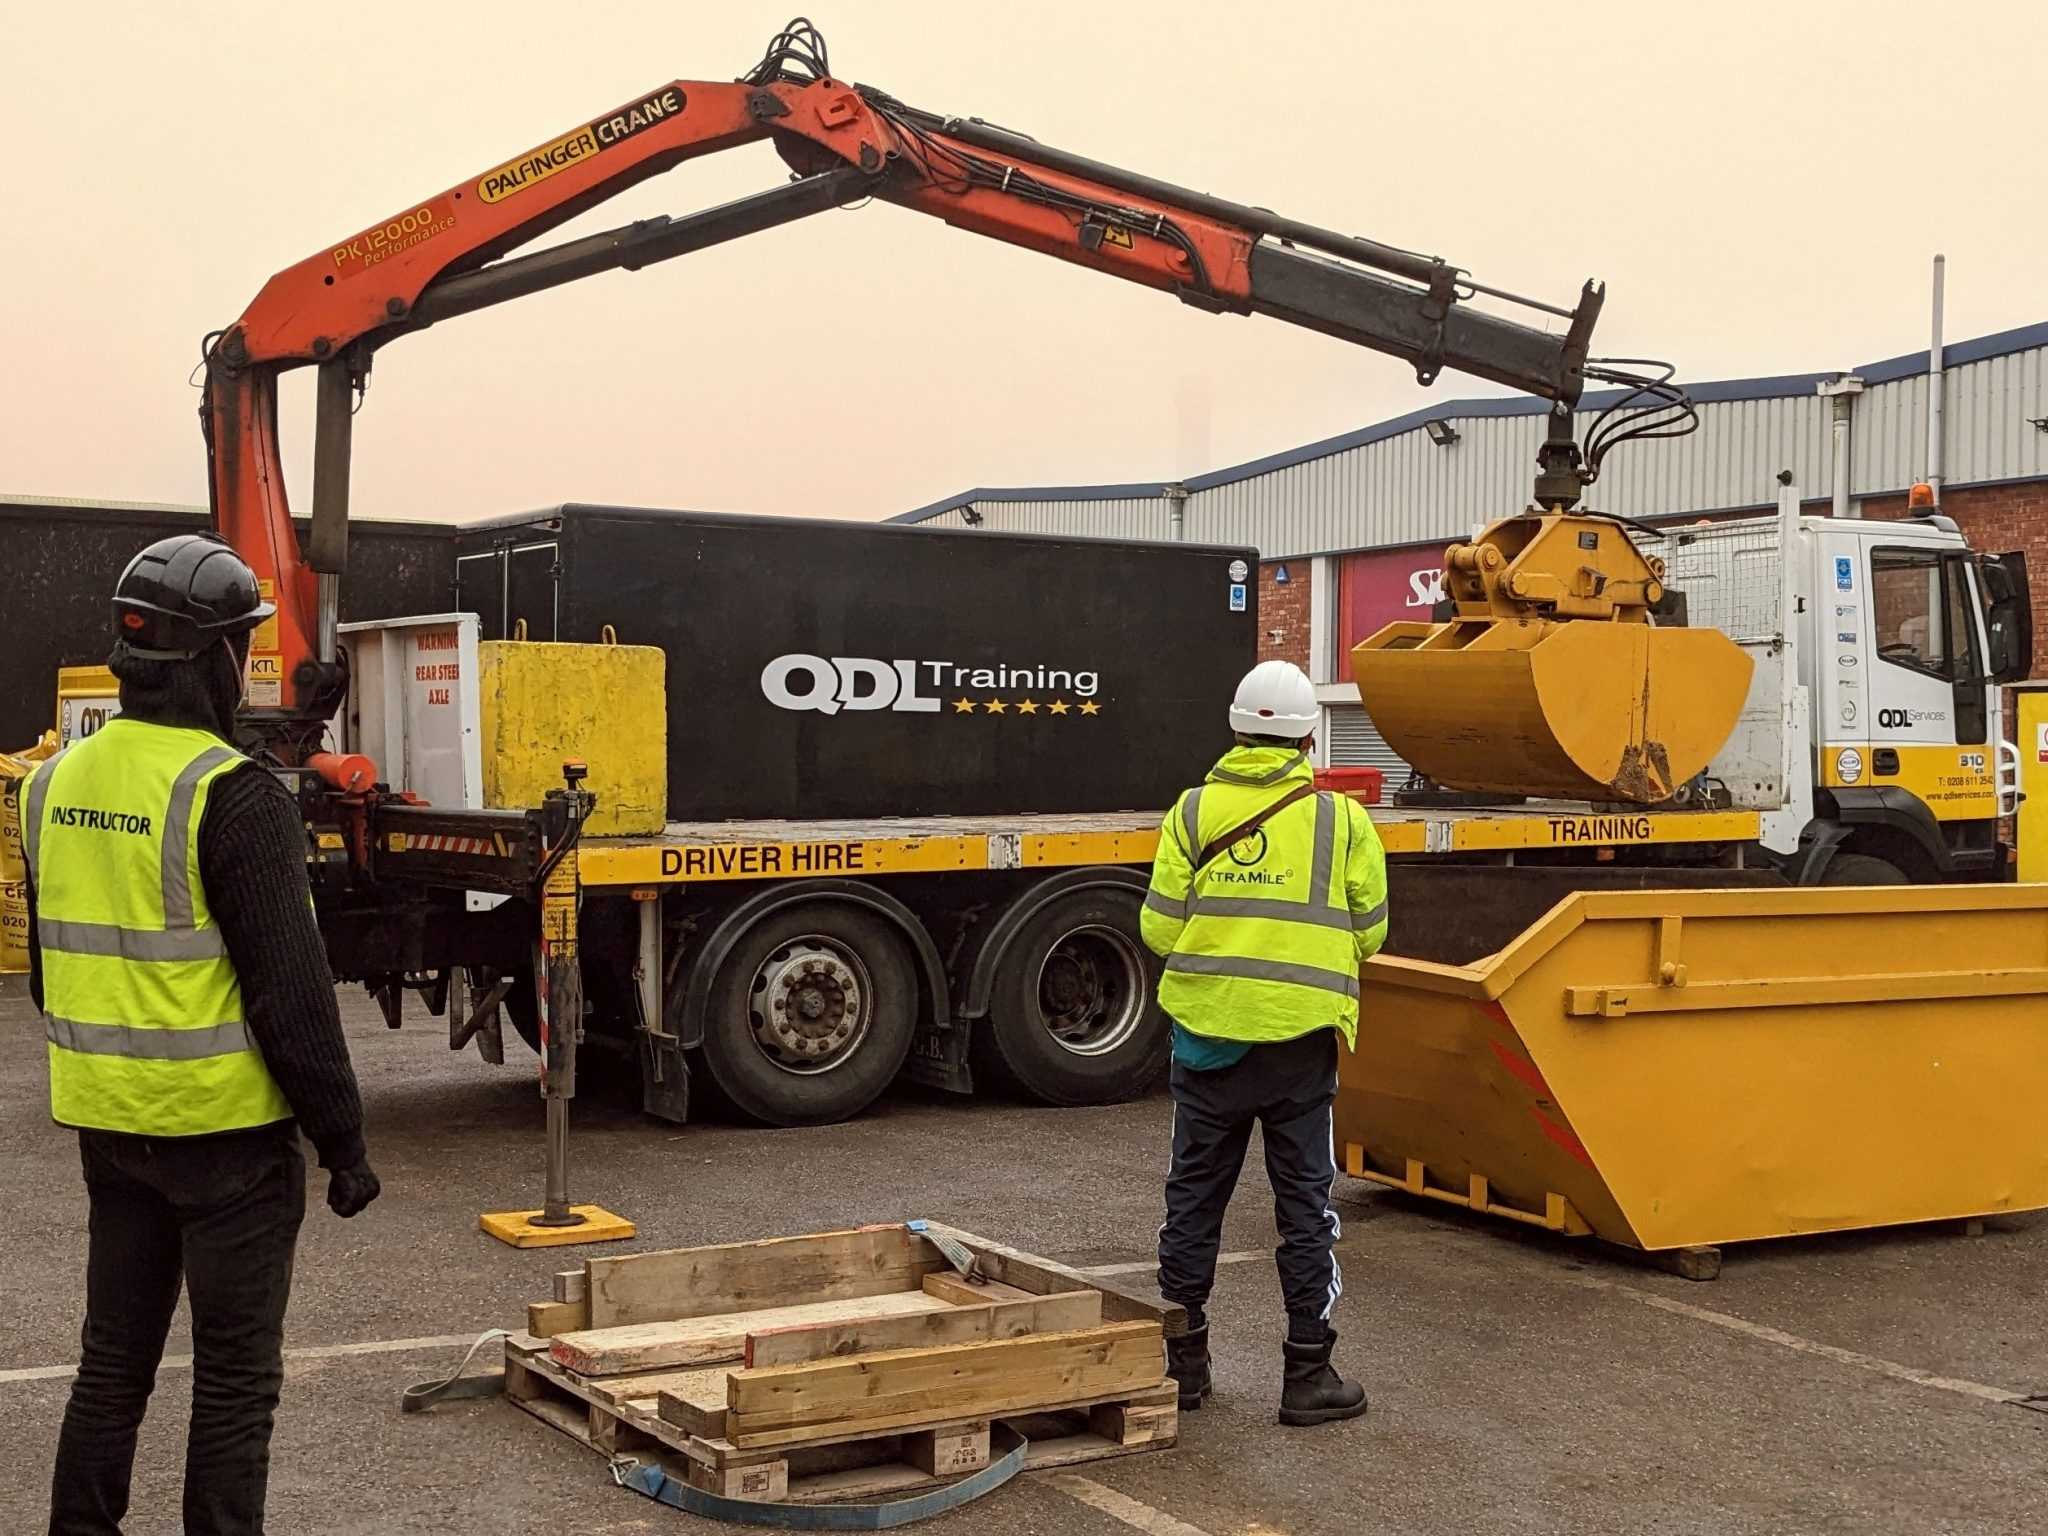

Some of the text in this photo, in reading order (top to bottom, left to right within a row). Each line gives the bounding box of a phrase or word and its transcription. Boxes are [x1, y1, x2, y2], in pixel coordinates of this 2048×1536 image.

[484, 91, 679, 198] PALFINGER CRANE
[333, 207, 432, 267] PK 12000
[364, 216, 456, 267] Performance
[251, 659, 280, 673] KTL
[416, 665, 437, 681] REAR
[428, 688, 449, 705] AXLE
[760, 653, 1099, 715] QDL Training
[1878, 708, 1946, 729] QDL Services
[51, 806, 151, 836] INSTRUCTOR
[1548, 817, 1650, 842] TRAINING
[661, 843, 864, 876] DRIVER HIRE
